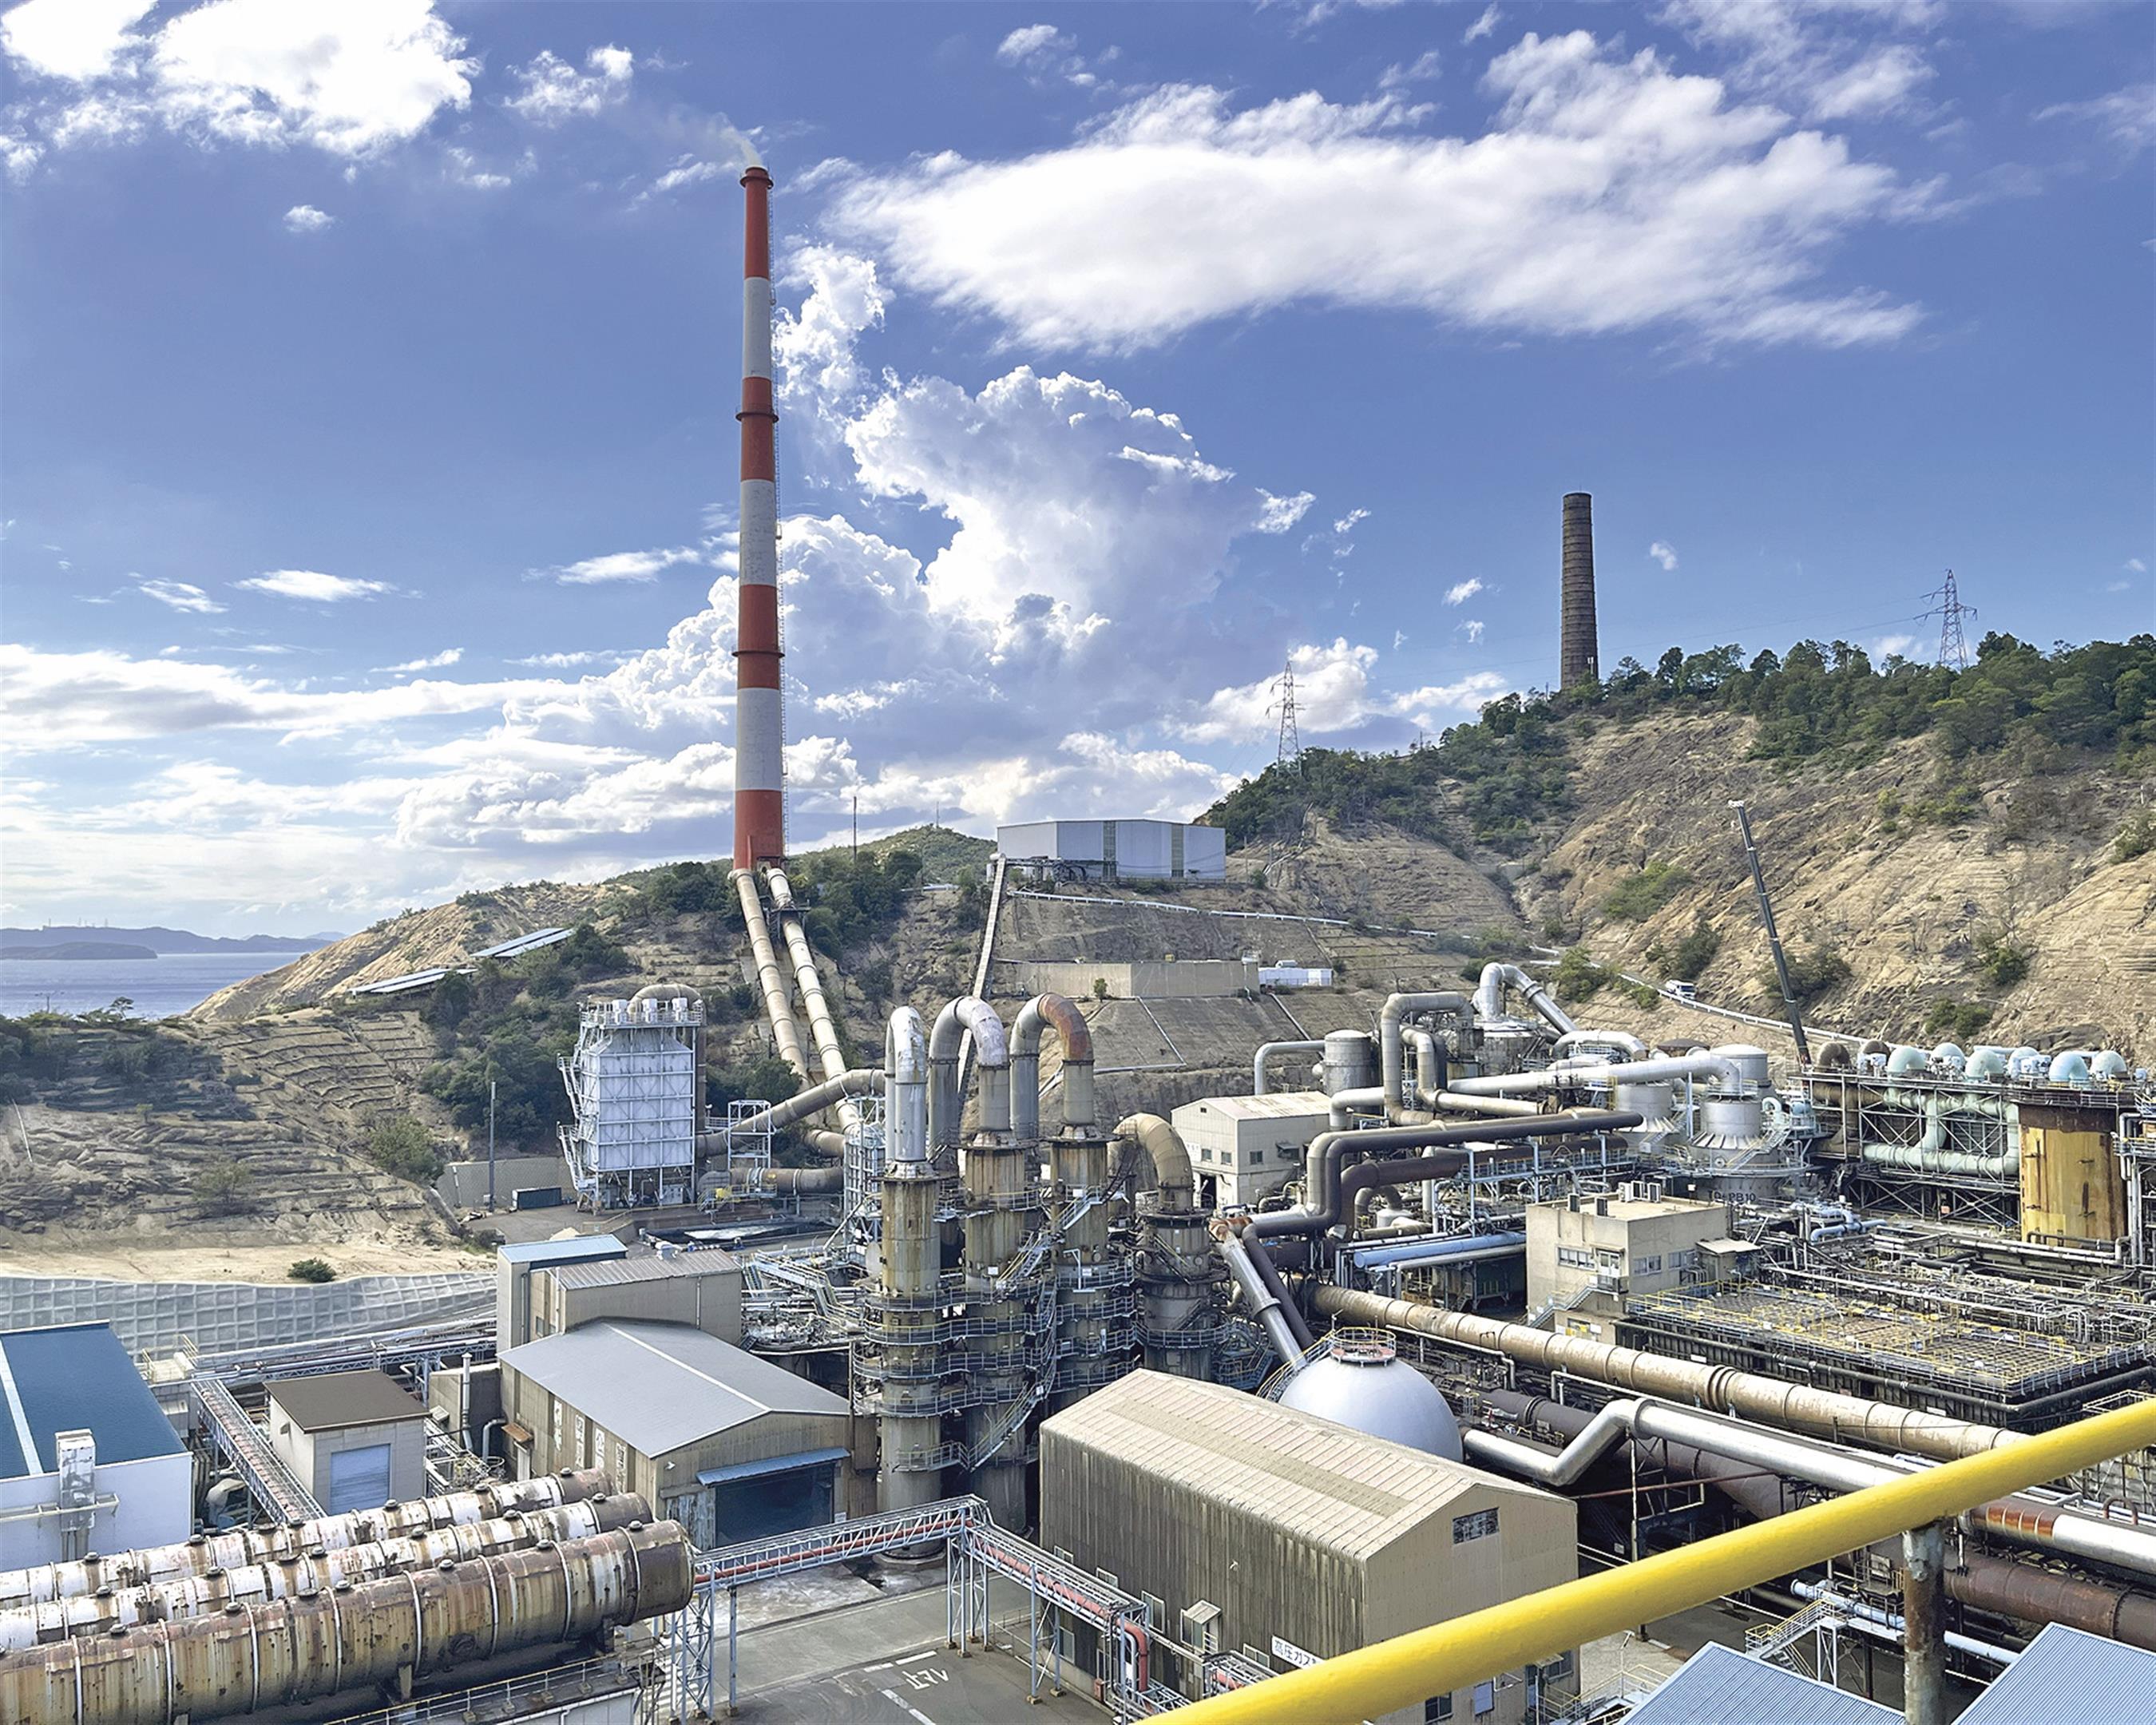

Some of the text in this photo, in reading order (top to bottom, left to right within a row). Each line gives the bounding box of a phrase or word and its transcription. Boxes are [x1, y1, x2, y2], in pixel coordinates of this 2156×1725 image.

[1274, 1640, 1316, 1666] 高圧ガス
[902, 1668, 949, 1690] 止マレ
